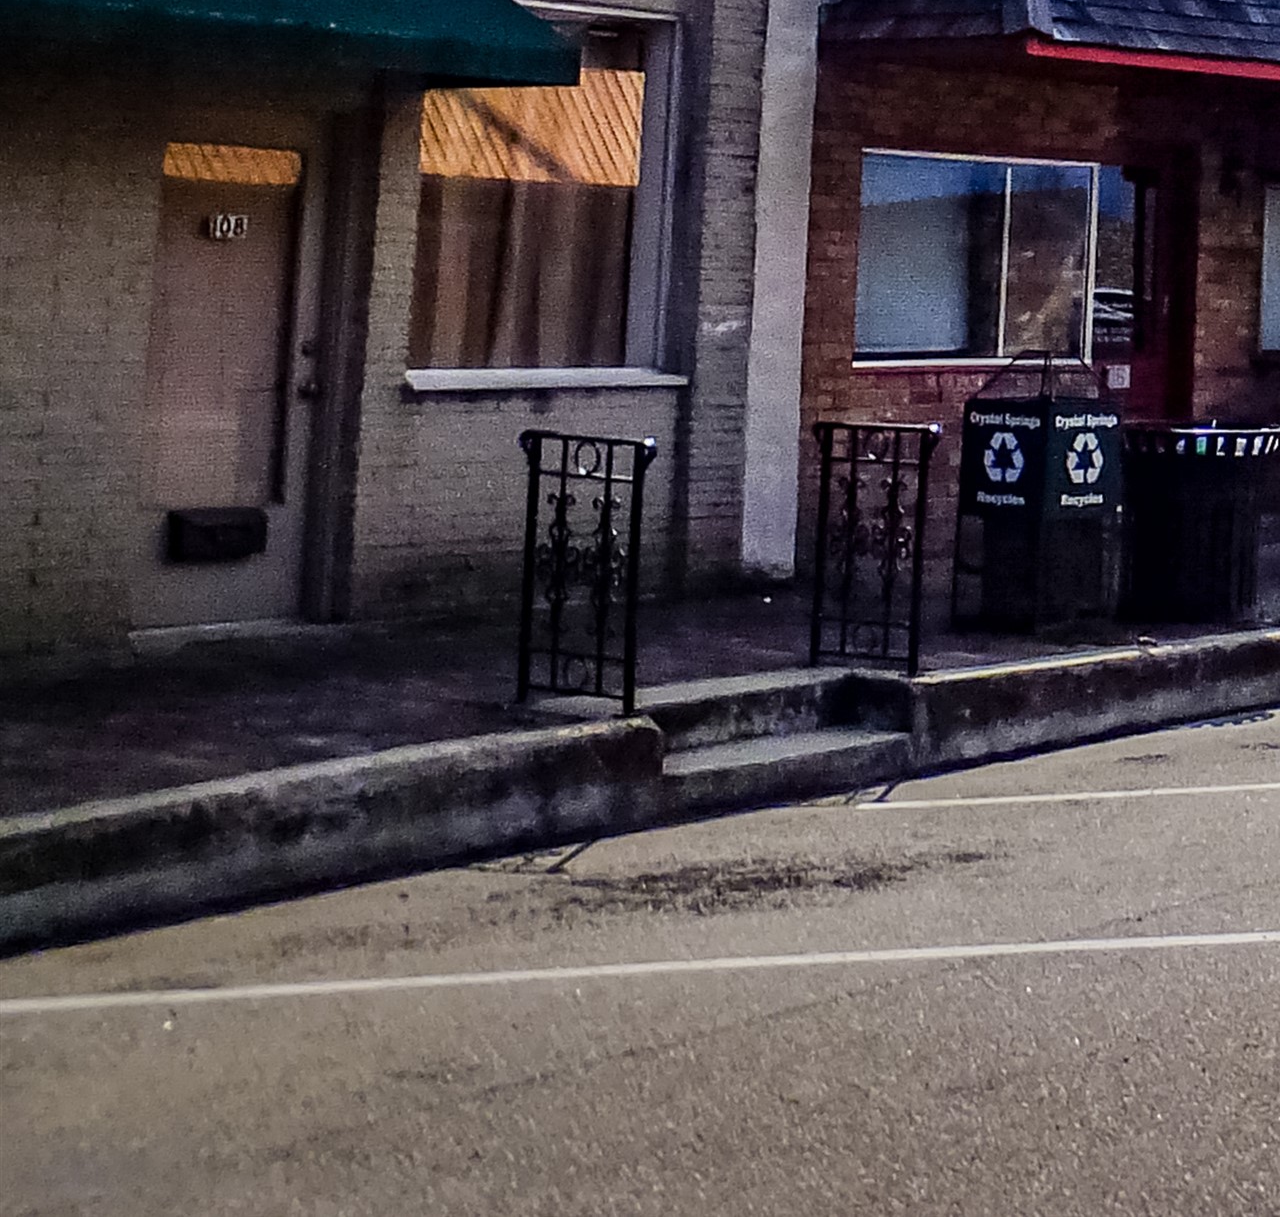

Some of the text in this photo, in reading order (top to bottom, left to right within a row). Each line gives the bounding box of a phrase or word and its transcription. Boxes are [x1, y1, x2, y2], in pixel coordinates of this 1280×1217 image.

[213, 215, 244, 237] 108
[970, 411, 1041, 430] Crystal Springs
[1055, 413, 1118, 430] Crystal Springs
